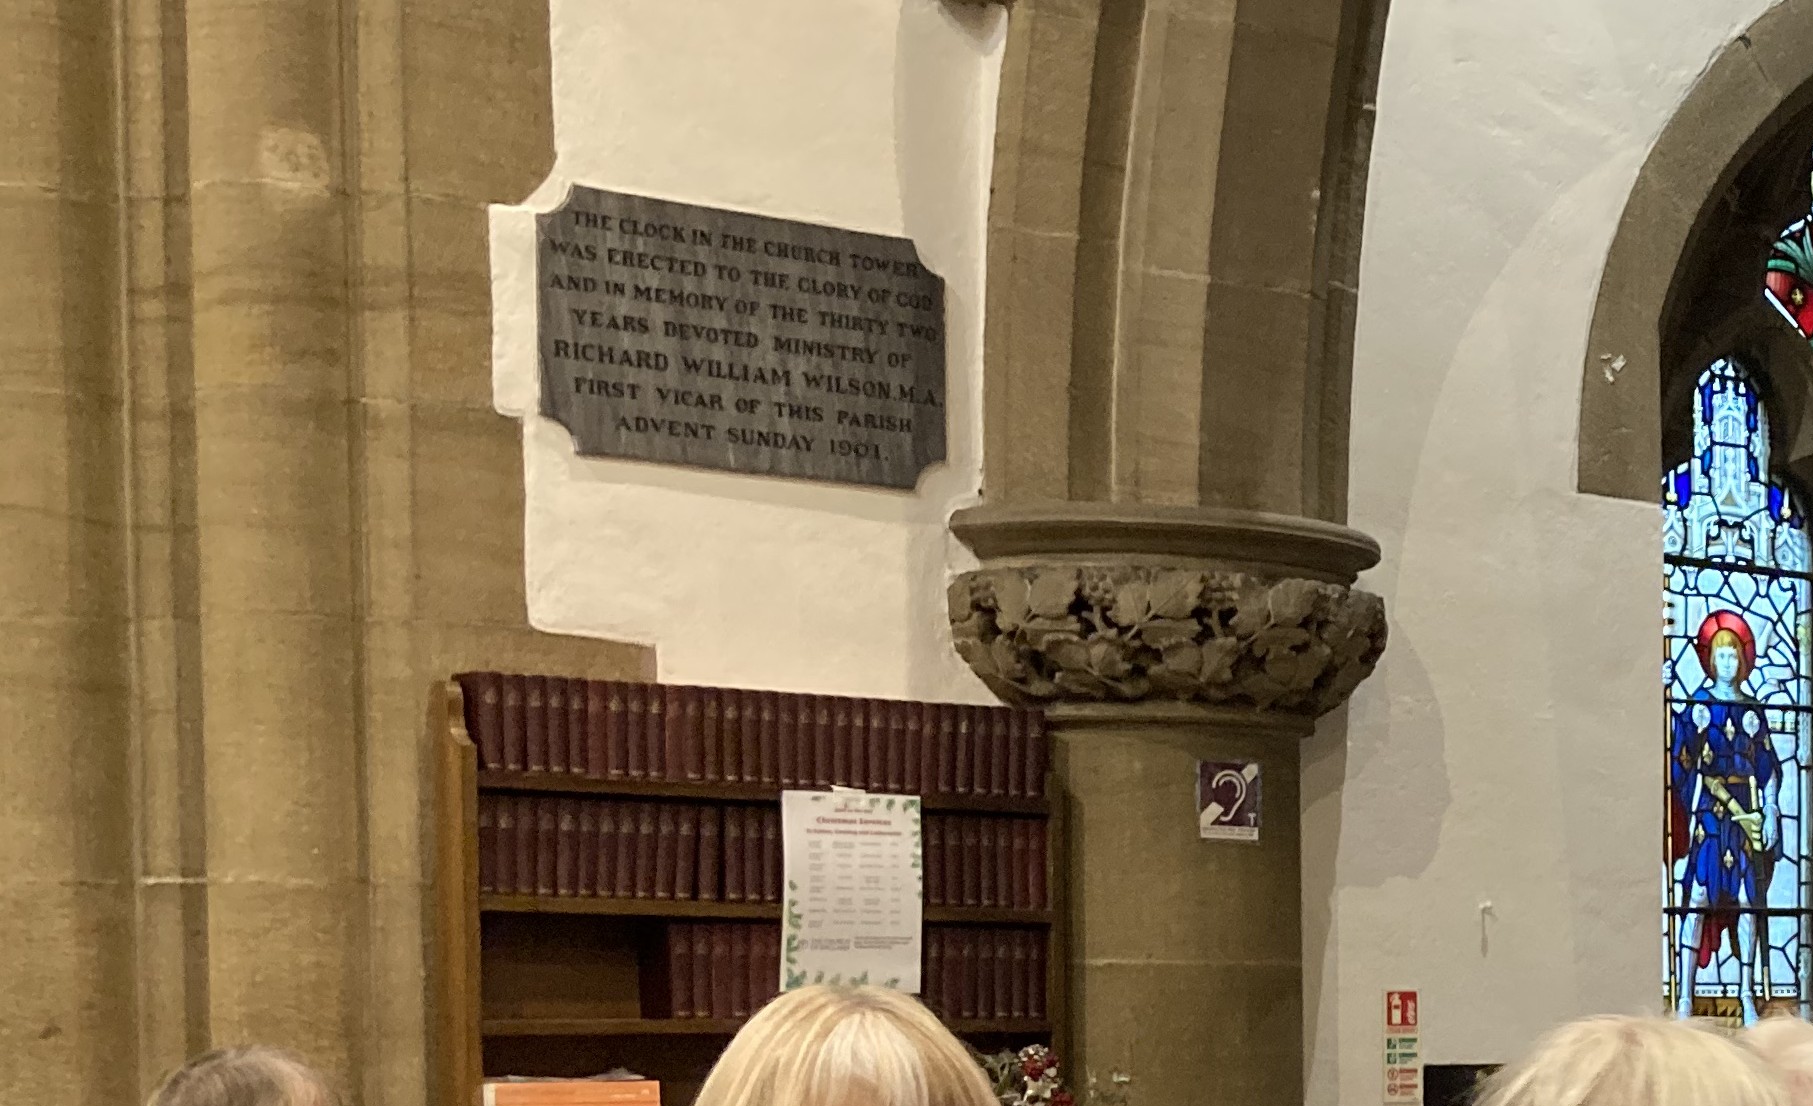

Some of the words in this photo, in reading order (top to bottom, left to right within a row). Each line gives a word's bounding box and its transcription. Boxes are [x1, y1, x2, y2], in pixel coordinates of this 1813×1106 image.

[573, 211, 612, 231] THE
[619, 218, 685, 243] CLOCK
[692, 228, 713, 247] IN
[721, 234, 757, 254] THE
[764, 241, 841, 267] CHURCH
[850, 254, 918, 277] TOWER
[550, 238, 597, 262] WAS
[608, 248, 706, 277] ERECTED
[715, 264, 741, 283] TO
[751, 270, 790, 290] THE
[798, 277, 861, 300] GLORY
[868, 288, 891, 304] OF
[896, 292, 932, 312] GOD
[550, 274, 598, 292] AND
[605, 280, 626, 296] IN
[634, 284, 726, 312] MEMORY
[734, 299, 760, 317] OF
[770, 303, 808, 324] THE
[818, 310, 889, 335] THIRTY
[897, 322, 937, 342] TWO
[572, 308, 650, 334] YEARS
[663, 321, 760, 348] DEVOTED
[774, 336, 879, 364] MINISTRY
[887, 352, 913, 369] OF
[554, 339, 669, 372] RICHARD
[682, 356, 791, 387] WILLIAM
[574, 377, 640, 400] FIRST
[656, 387, 725, 411] VICAR
[735, 398, 761, 415] OF
[773, 402, 824, 423] THIS
[837, 410, 912, 433] PARISH
[615, 416, 716, 440] ADVENT
[727, 427, 815, 453] SUNDAY
